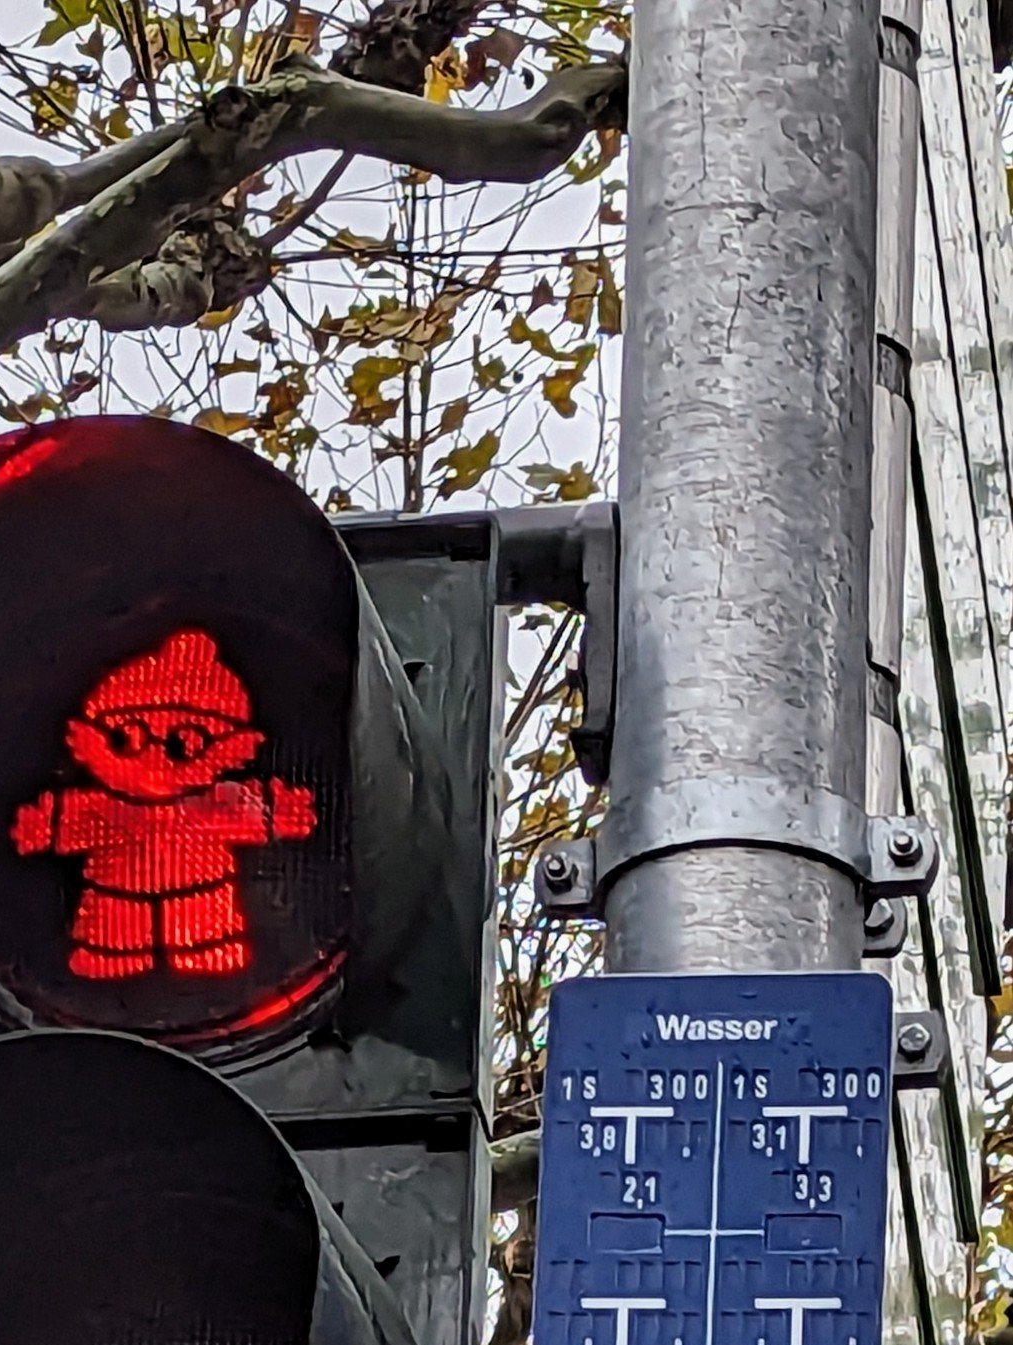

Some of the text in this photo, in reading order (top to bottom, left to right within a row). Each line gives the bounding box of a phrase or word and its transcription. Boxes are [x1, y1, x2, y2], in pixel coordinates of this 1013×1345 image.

[656, 1014, 779, 1041] Wasser
[650, 1074, 708, 1100] 300
[822, 1072, 881, 1098] 300
